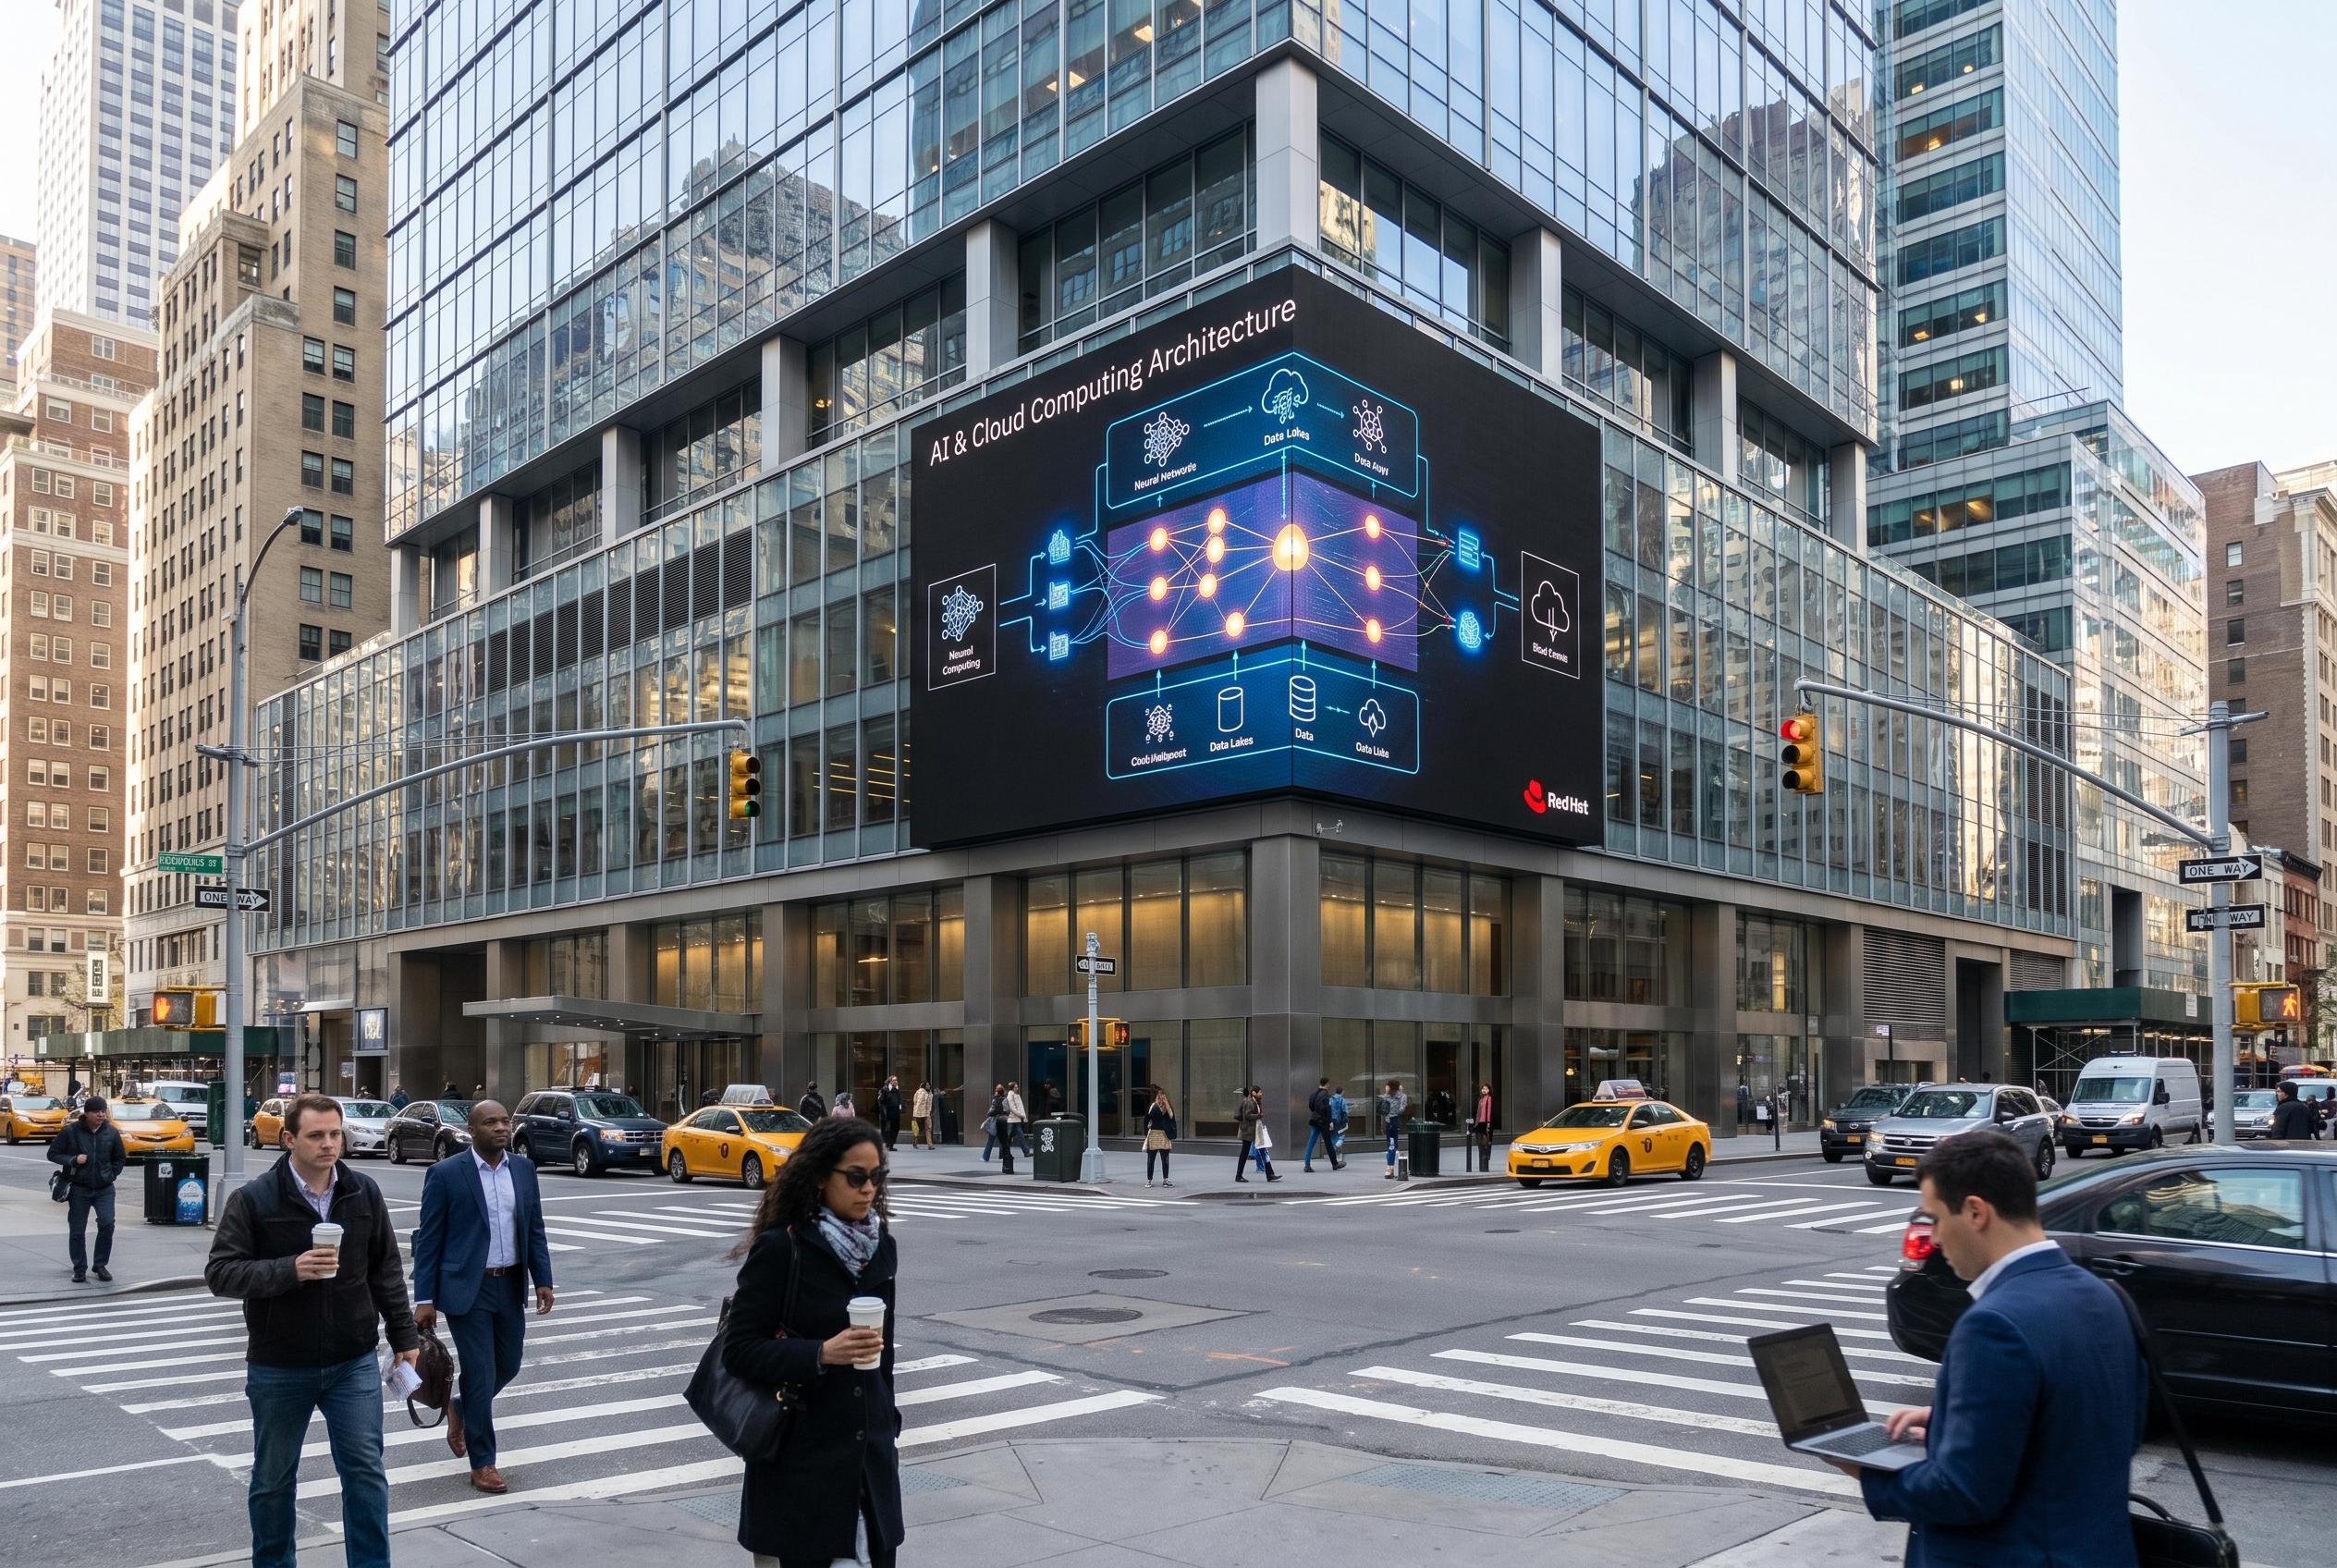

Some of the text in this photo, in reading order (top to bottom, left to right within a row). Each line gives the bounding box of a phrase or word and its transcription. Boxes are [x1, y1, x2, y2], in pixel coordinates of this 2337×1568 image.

[930, 299, 1296, 467] AI & Cloud Computing Architecture
[1134, 472, 1159, 491] Neural
[942, 658, 981, 676] Computing
[1294, 728, 1314, 741] Data
[1209, 736, 1254, 753] Data Lakes
[1548, 791, 1569, 811] Red
[2189, 864, 2248, 876] ONE WAY
[2229, 912, 2254, 923] WAY
